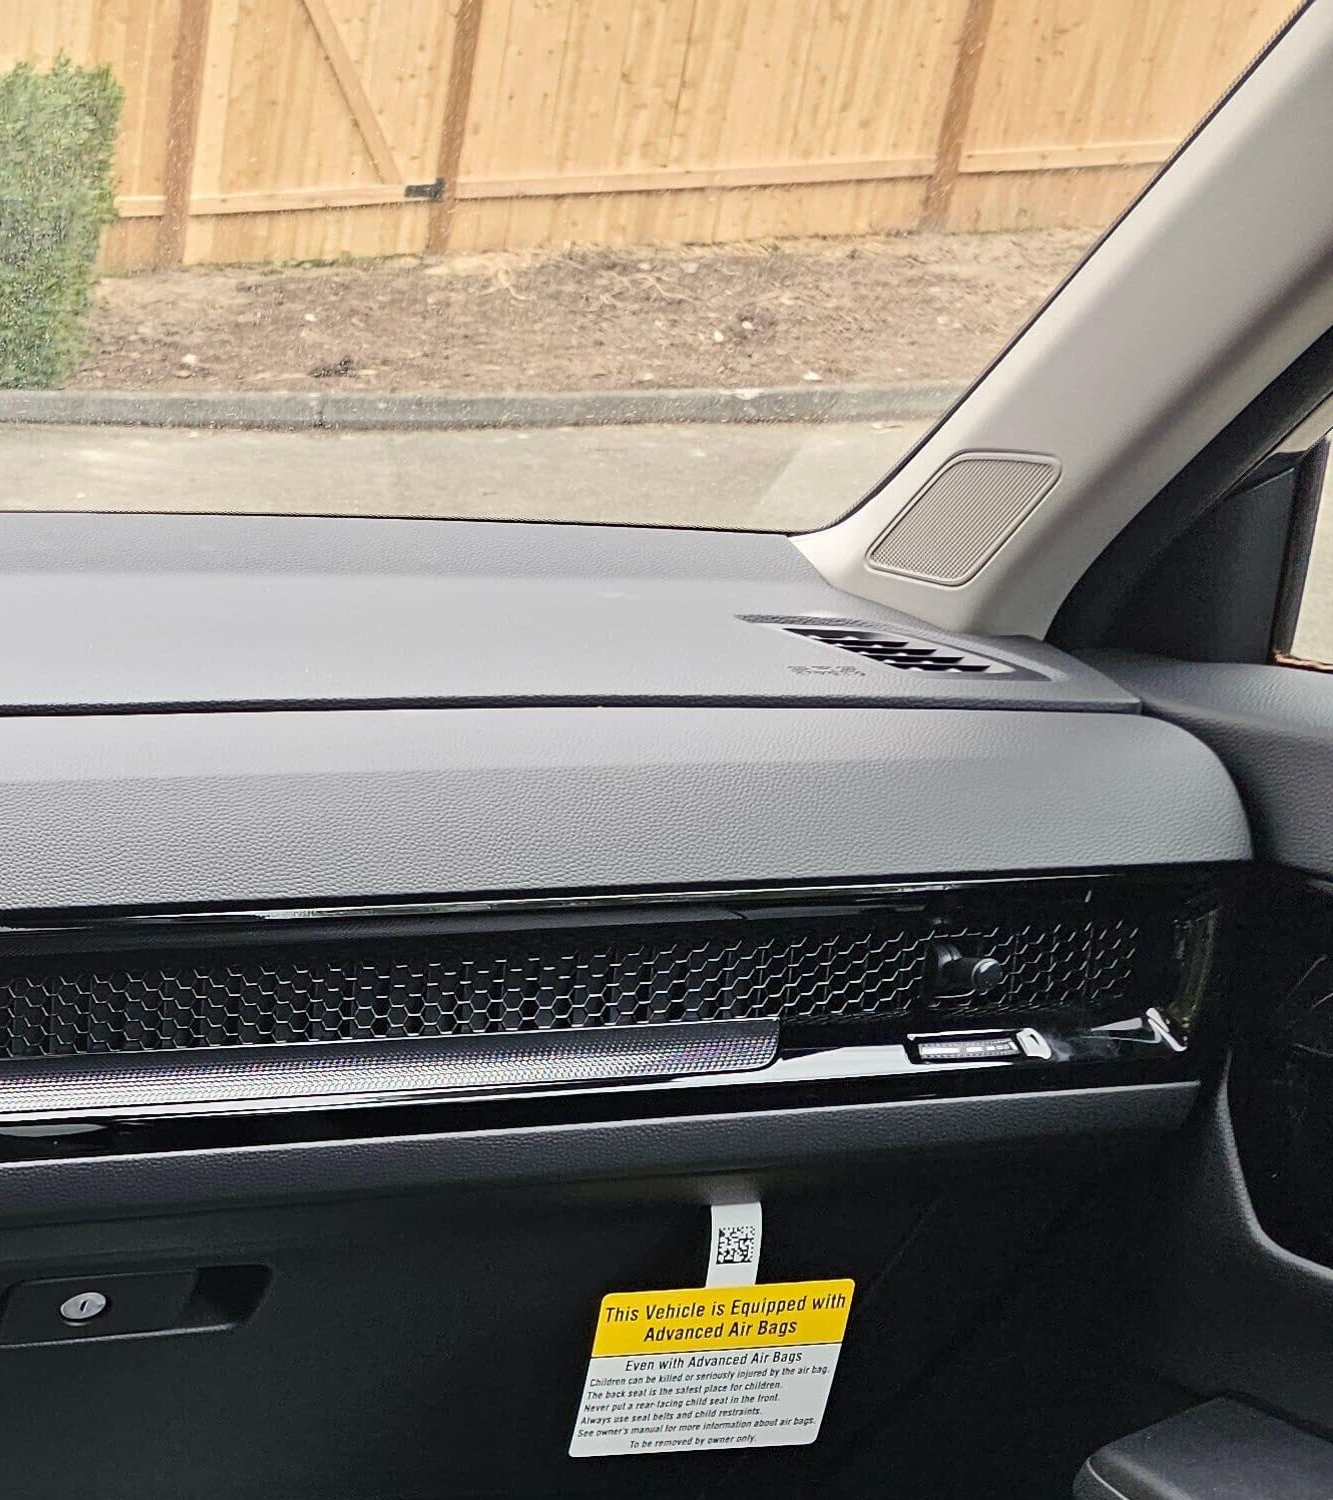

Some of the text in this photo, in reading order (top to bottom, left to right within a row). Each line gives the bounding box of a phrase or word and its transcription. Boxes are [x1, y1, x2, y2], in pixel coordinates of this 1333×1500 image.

[605, 1294, 846, 1323] This Vehicle is Equipped with
[644, 1320, 798, 1342] Advanced Air Bags
[625, 1351, 803, 1373] Even with Advanced Air Bags
[589, 1378, 626, 1387] Children
[628, 1377, 643, 1385] can
[645, 1375, 656, 1384] be
[658, 1373, 683, 1383] killed
[685, 1373, 694, 1381] or
[696, 1370, 737, 1381] seriously
[737, 1369, 767, 1379] injured
[769, 1367, 780, 1377] by
[782, 1366, 795, 1376] the
[797, 1366, 810, 1374] air
[741, 1394, 755, 1403] the
[654, 1436, 693, 1447] removed
